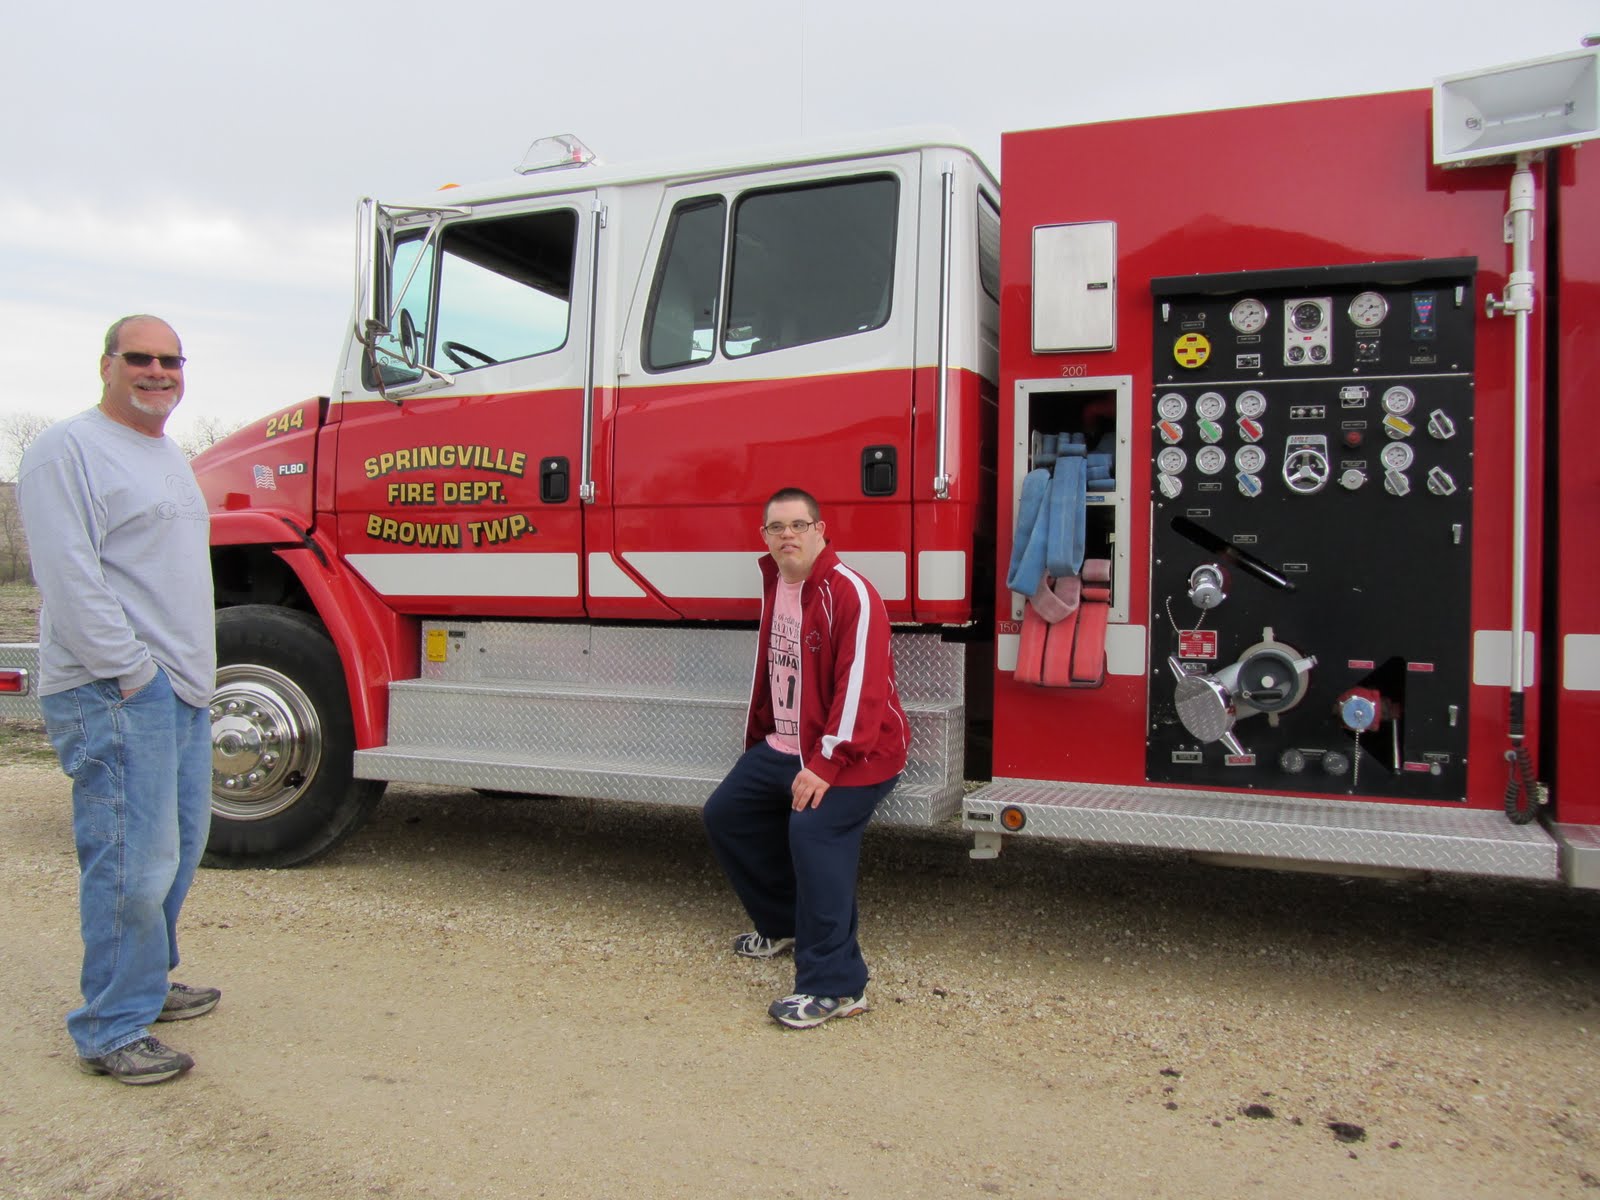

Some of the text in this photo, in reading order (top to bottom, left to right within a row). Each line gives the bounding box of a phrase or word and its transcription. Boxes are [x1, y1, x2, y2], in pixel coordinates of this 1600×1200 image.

[265, 408, 304, 440] 244
[278, 463, 304, 476] FL80
[364, 445, 527, 479] SPRINGVILLE
[387, 481, 507, 504] FIRE DEPT.
[366, 513, 535, 547] BROWN TWP.
